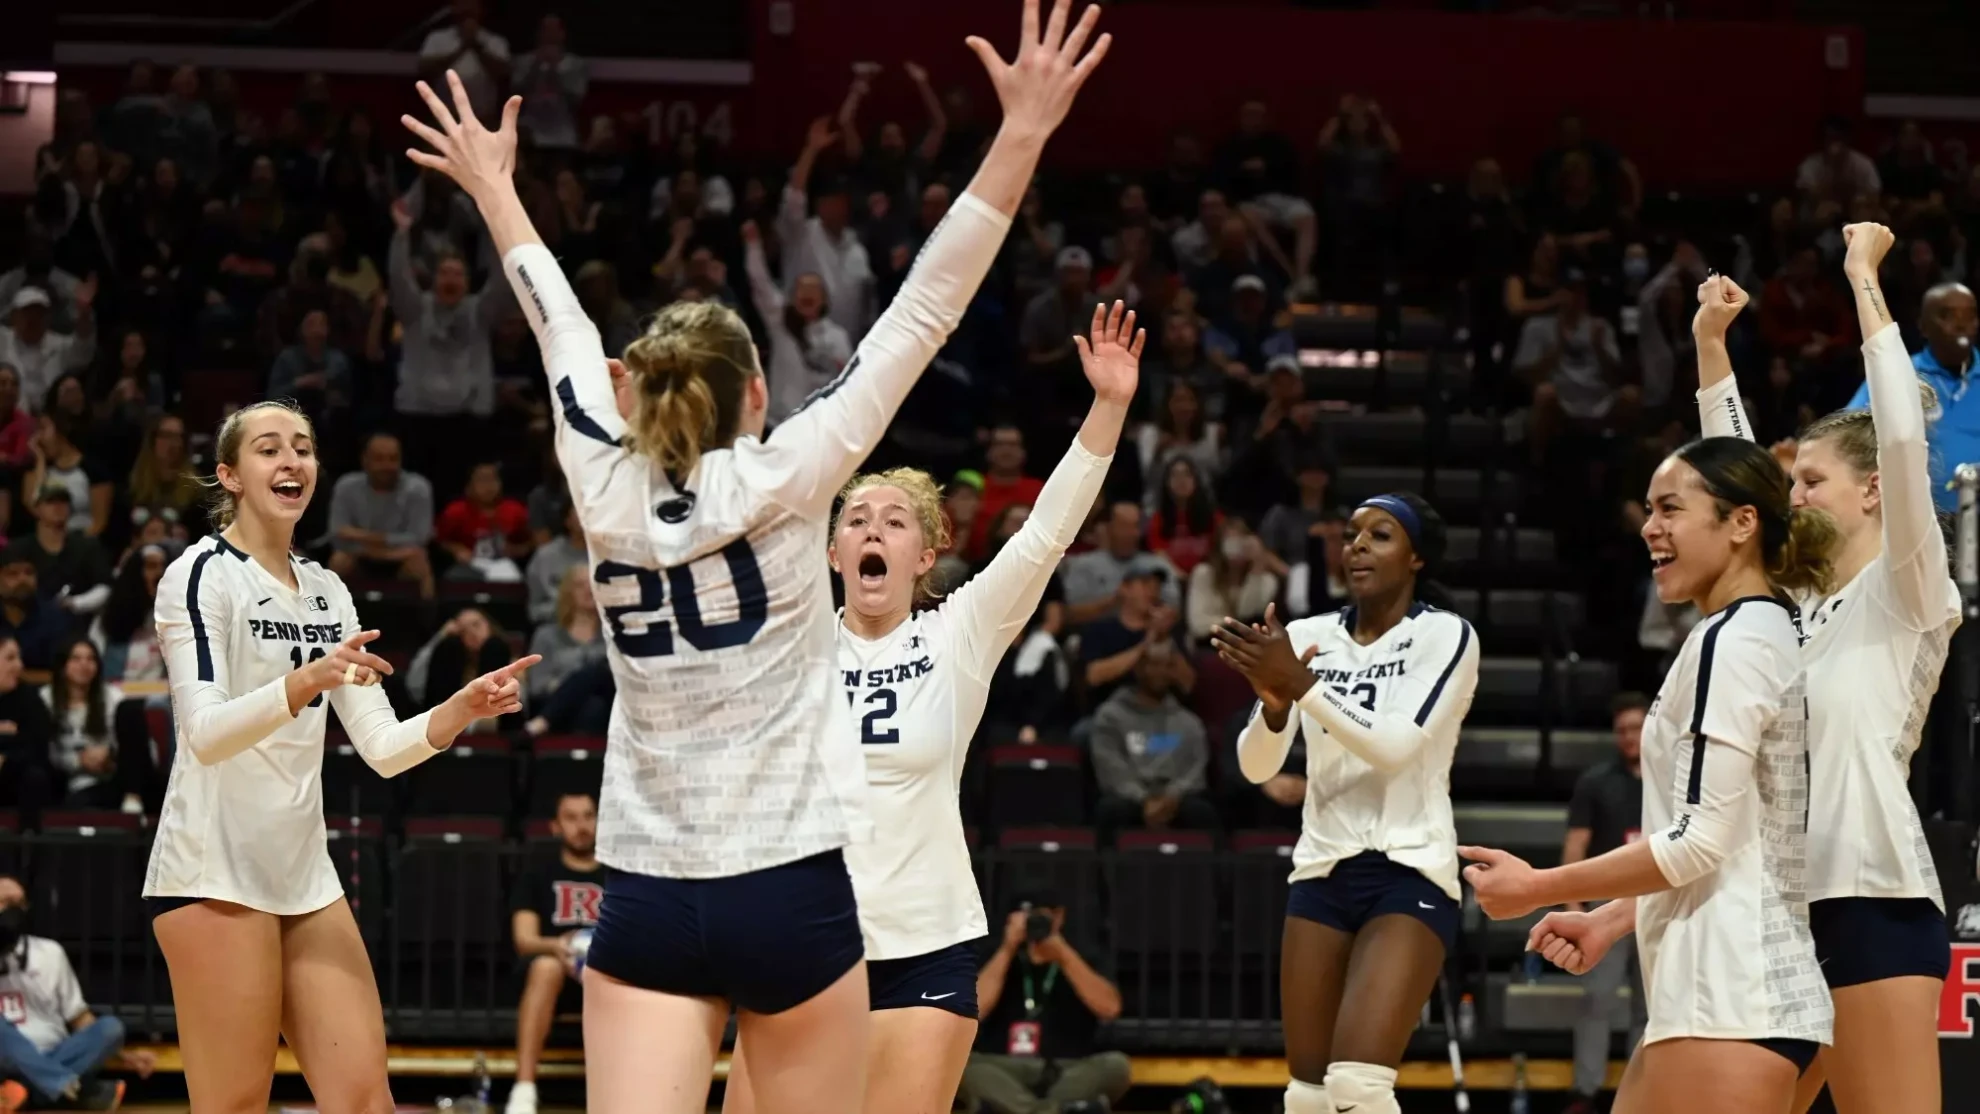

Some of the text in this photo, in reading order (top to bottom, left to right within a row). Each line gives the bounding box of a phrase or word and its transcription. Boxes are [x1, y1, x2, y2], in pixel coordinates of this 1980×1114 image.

[641, 101, 732, 146] 104
[1726, 397, 1744, 437] NITTANY
[594, 536, 767, 658] 20
[1308, 667, 1352, 683] ENN
[551, 880, 604, 927] R
